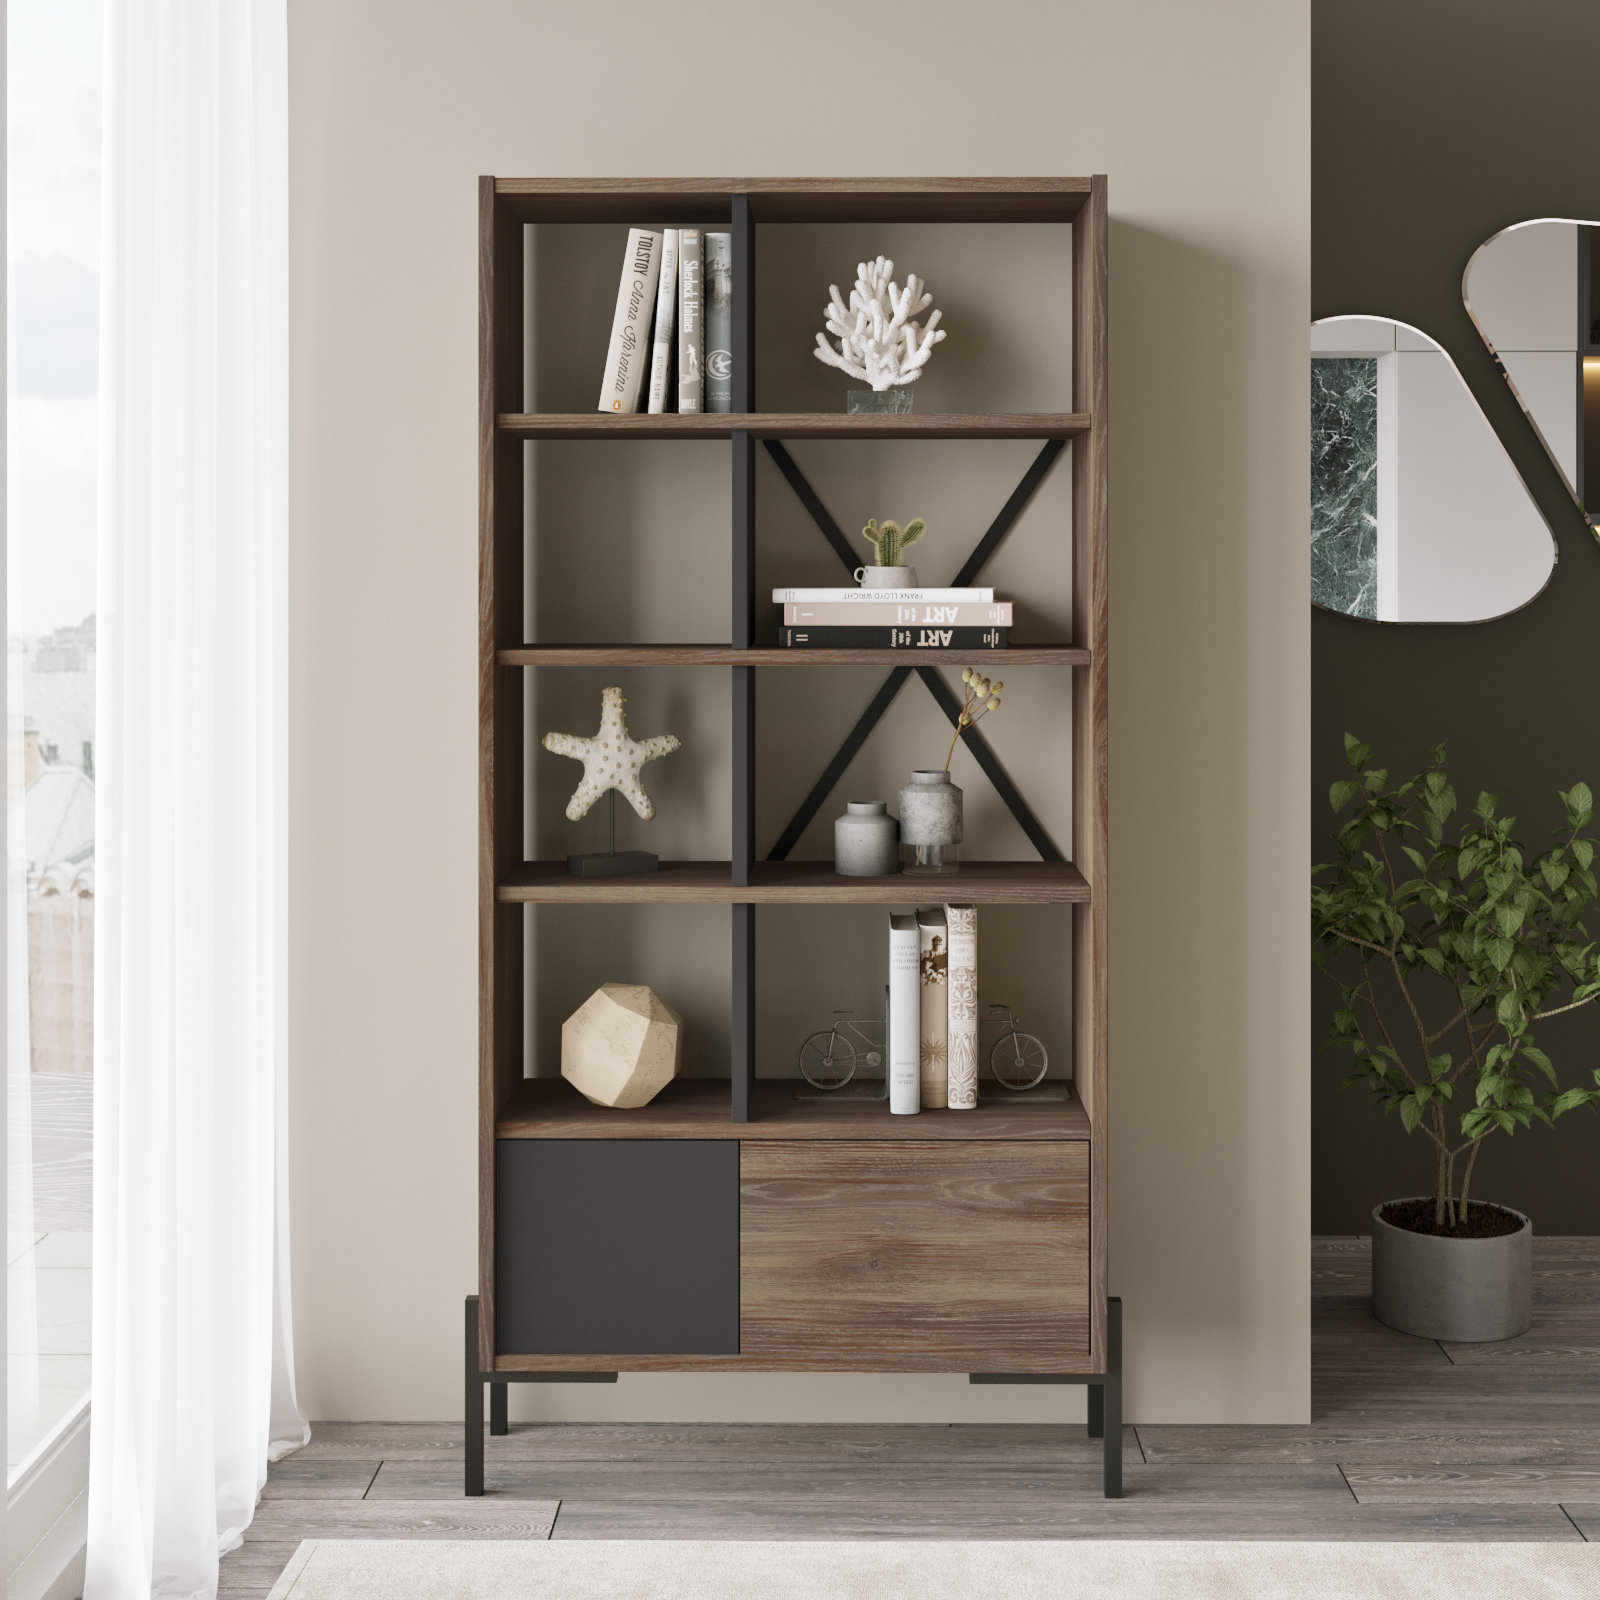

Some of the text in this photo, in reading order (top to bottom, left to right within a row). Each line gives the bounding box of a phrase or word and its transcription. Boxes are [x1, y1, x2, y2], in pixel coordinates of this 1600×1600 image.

[683, 260, 699, 334] Sherlock Holmes
[615, 236, 654, 394] TOLSTOY Anna Karenina
[842, 592, 924, 600] FRANK LLOYD WRIGHT
[922, 606, 959, 624] ART
[916, 629, 954, 647] ART
